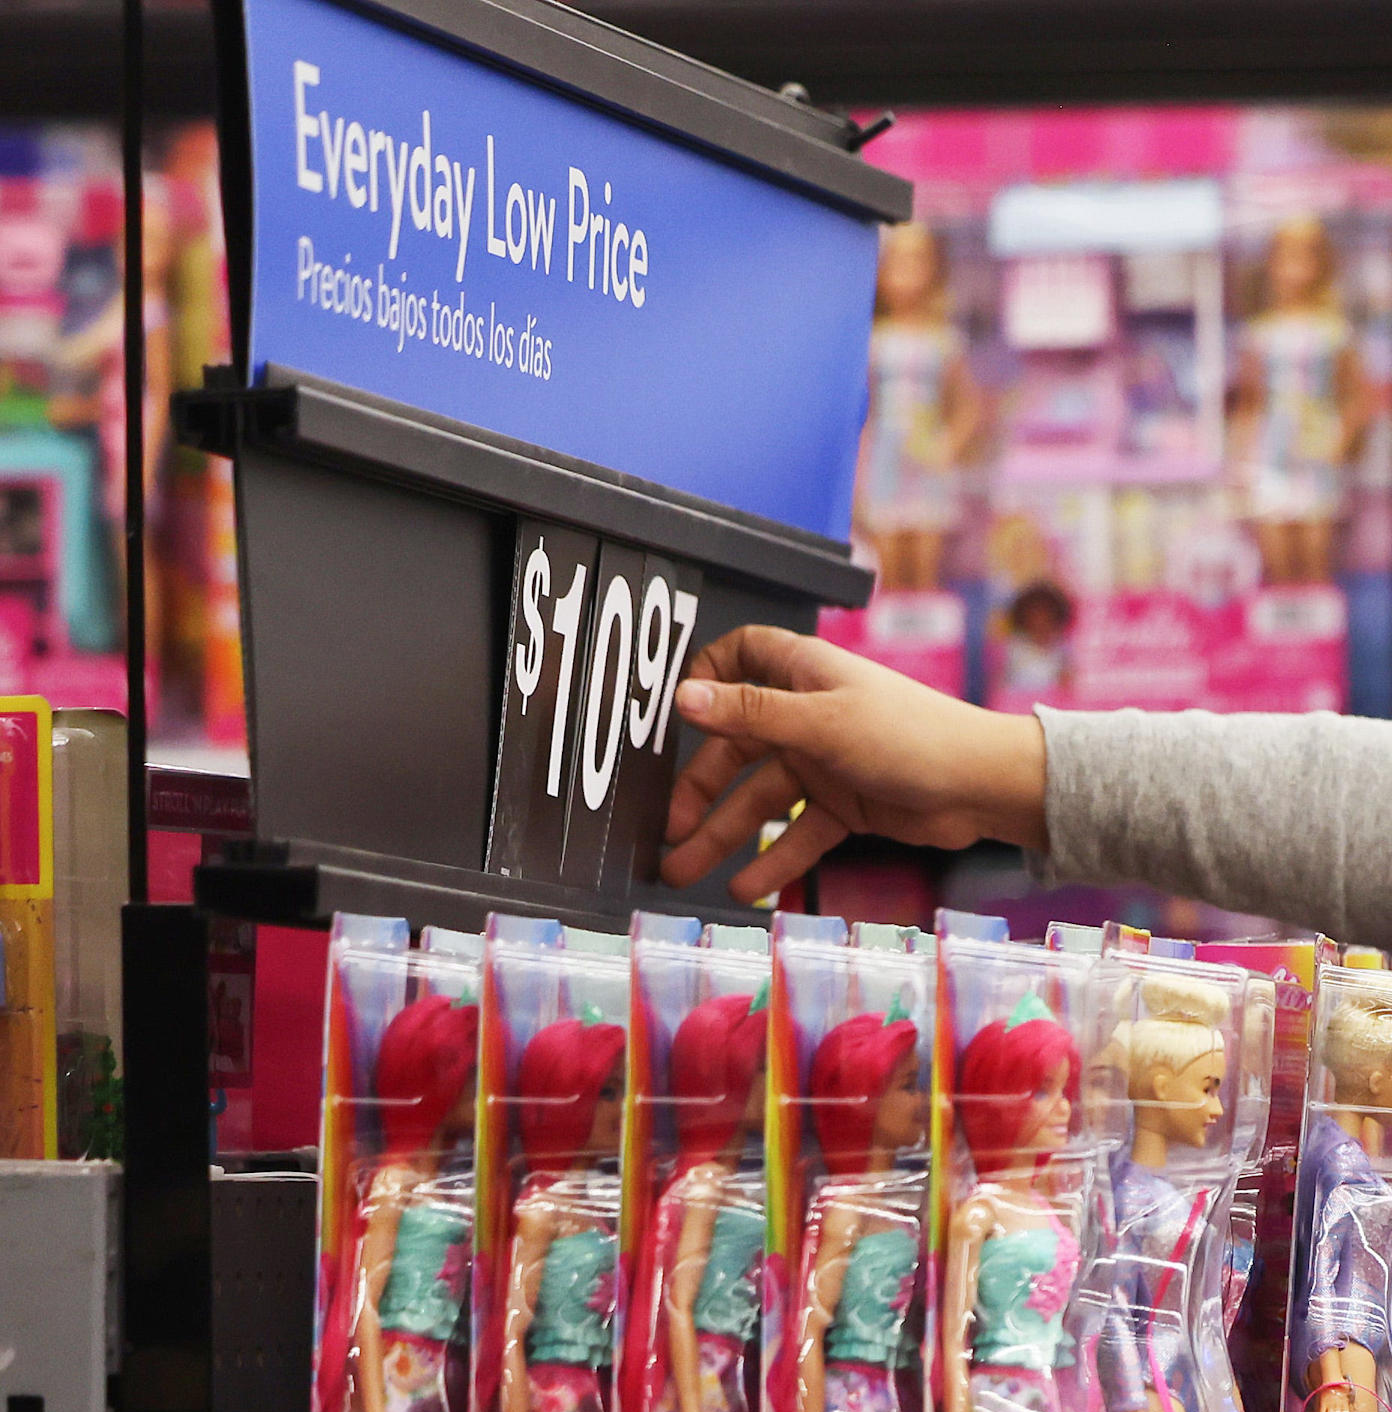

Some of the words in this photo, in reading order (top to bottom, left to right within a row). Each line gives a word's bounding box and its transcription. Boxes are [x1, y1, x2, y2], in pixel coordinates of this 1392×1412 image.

[293, 59, 476, 283] Everyday
[486, 134, 556, 275] Low
[567, 166, 649, 309] Price
[297, 235, 373, 323] Precios
[376, 263, 428, 353] bajos
[431, 289, 485, 359] todos
[488, 302, 514, 369] los
[517, 314, 553, 381] días
